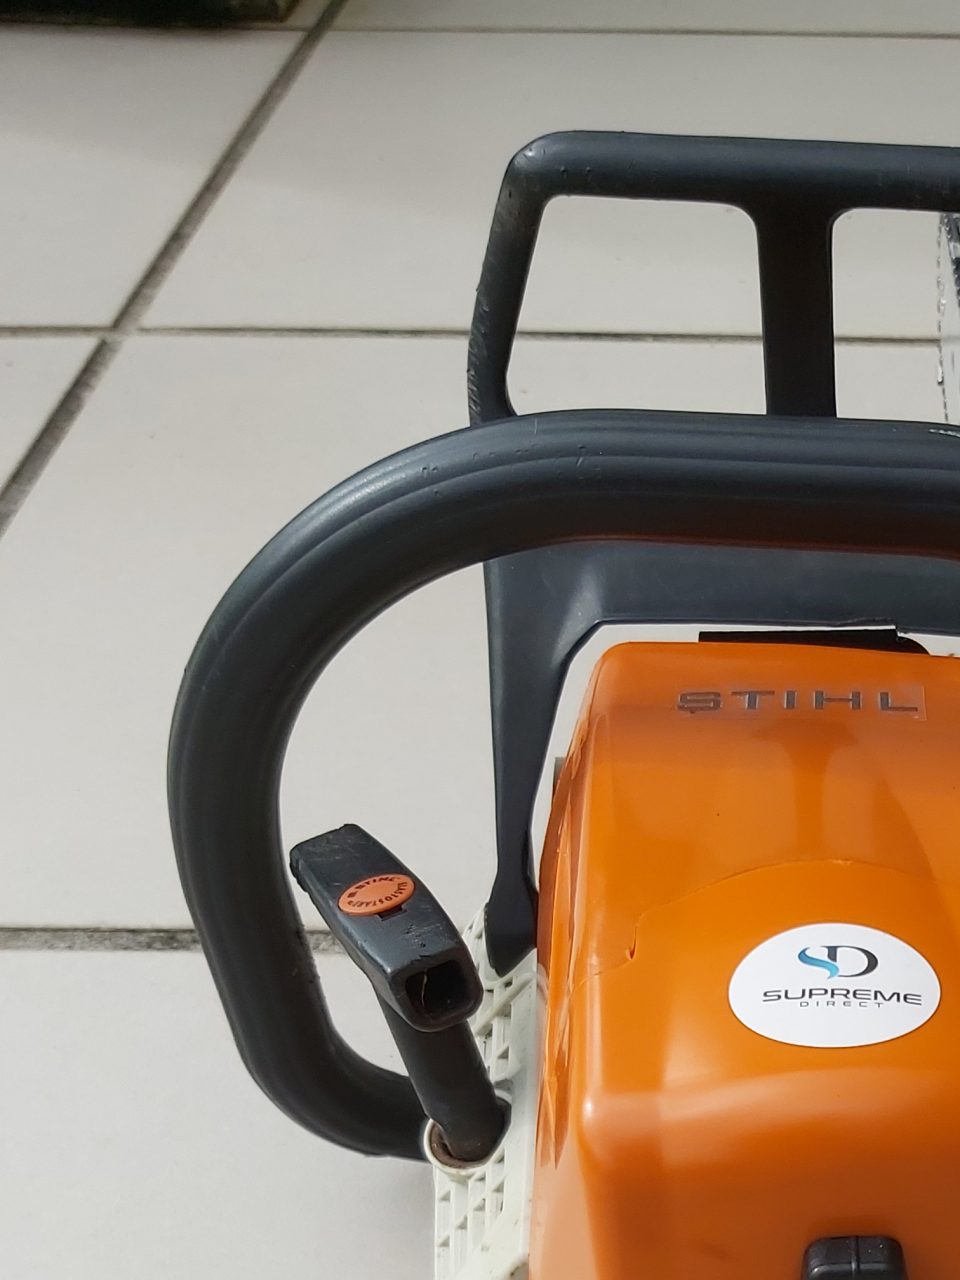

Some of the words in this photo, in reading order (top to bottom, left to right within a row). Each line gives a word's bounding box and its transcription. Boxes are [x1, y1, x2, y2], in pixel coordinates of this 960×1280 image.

[677, 690, 919, 713] STIHL
[762, 987, 923, 1006] SUPREME
[799, 1000, 884, 1009] DIRECT
